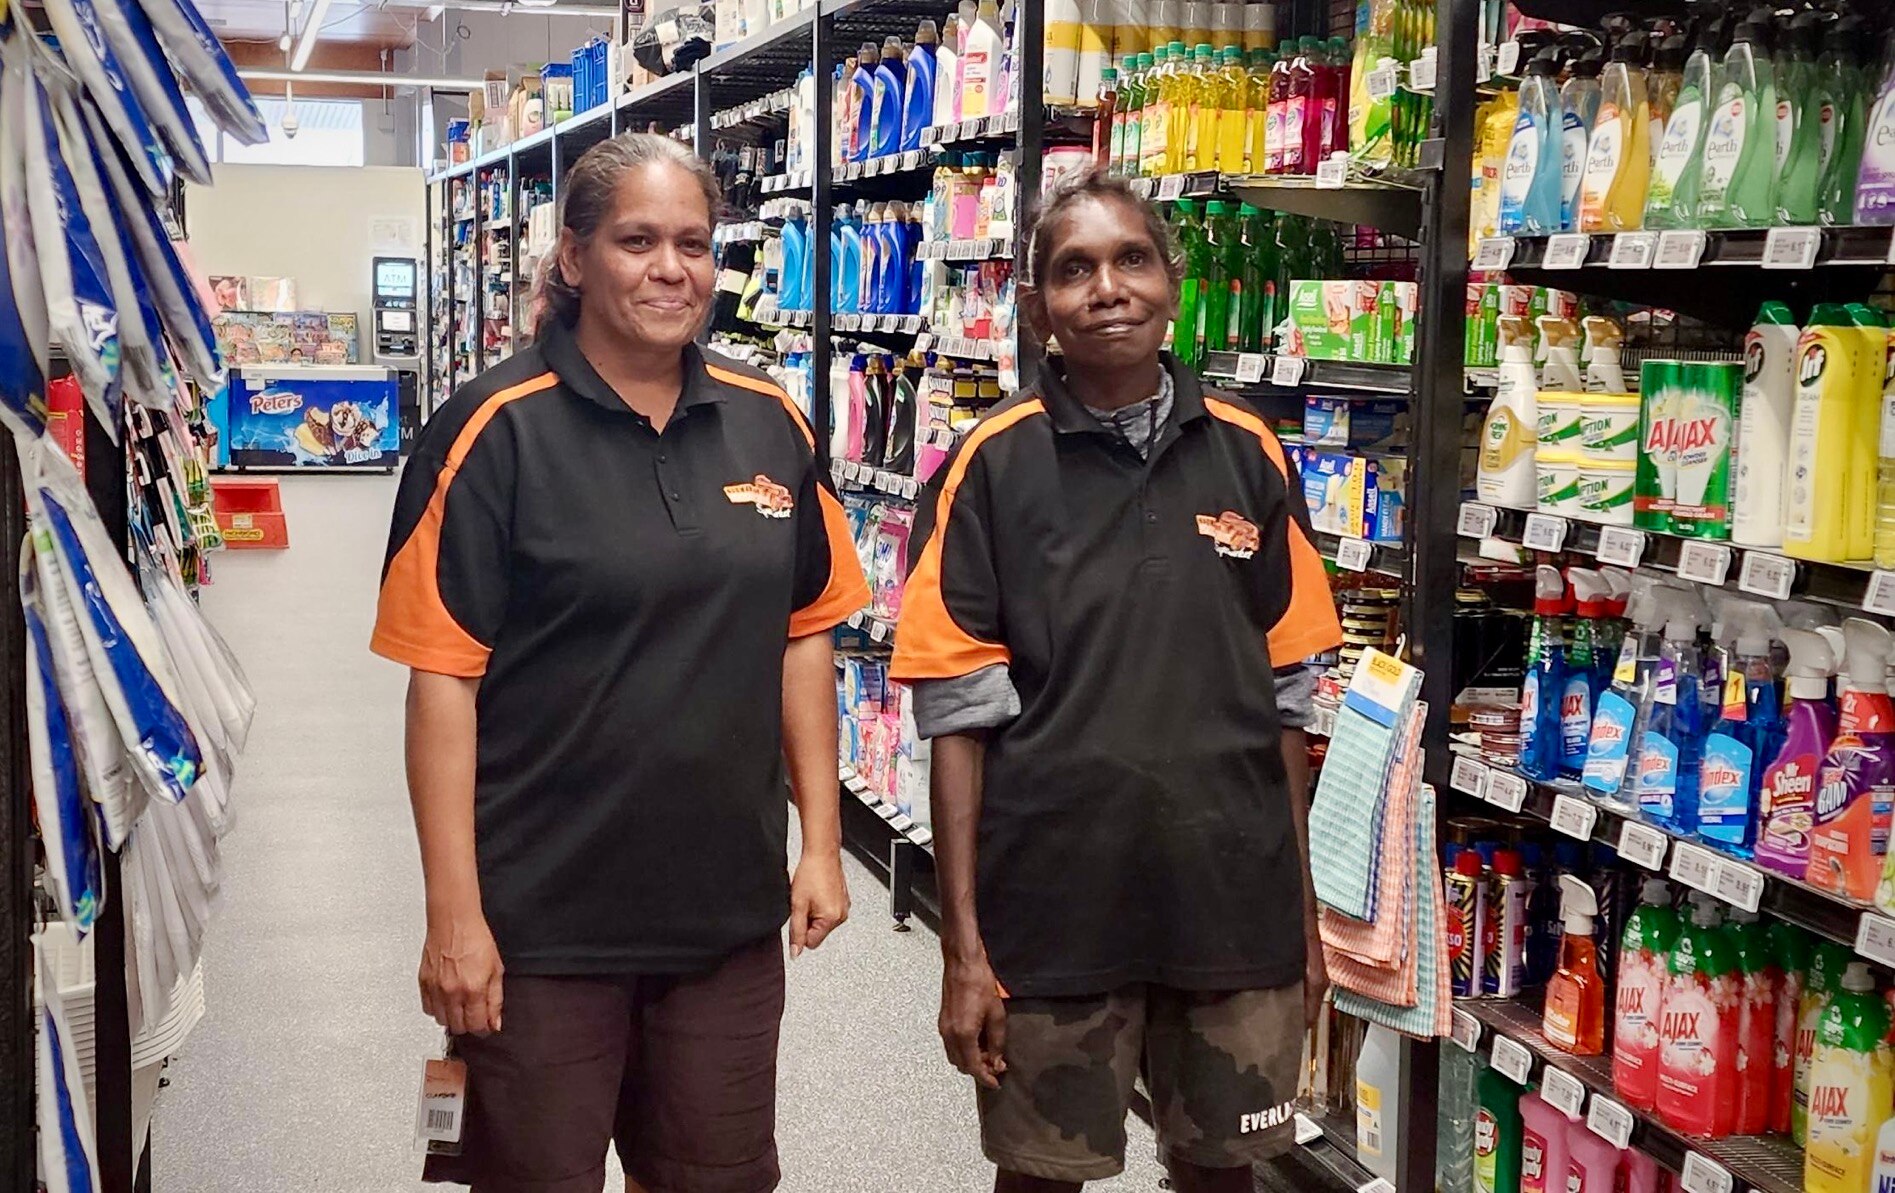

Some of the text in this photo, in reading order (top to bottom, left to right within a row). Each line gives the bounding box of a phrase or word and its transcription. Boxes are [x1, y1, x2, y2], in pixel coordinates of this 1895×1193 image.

[1661, 139, 1688, 159] earth
[1708, 139, 1737, 160] earth
[1506, 161, 1531, 179] earth
[1563, 161, 1579, 173] rth
[1588, 155, 1614, 174] earth
[384, 273, 408, 283] ATM
[252, 391, 302, 414] Peters
[345, 450, 371, 464] Dive
[1365, 485, 1378, 516] Ansell
[1773, 775, 1812, 798] Sheen
[1618, 986, 1646, 1020] AJAX
[1661, 1012, 1701, 1045] AJAX
[1811, 1085, 1850, 1122] AJAX
[1240, 1101, 1294, 1133] EVERL
